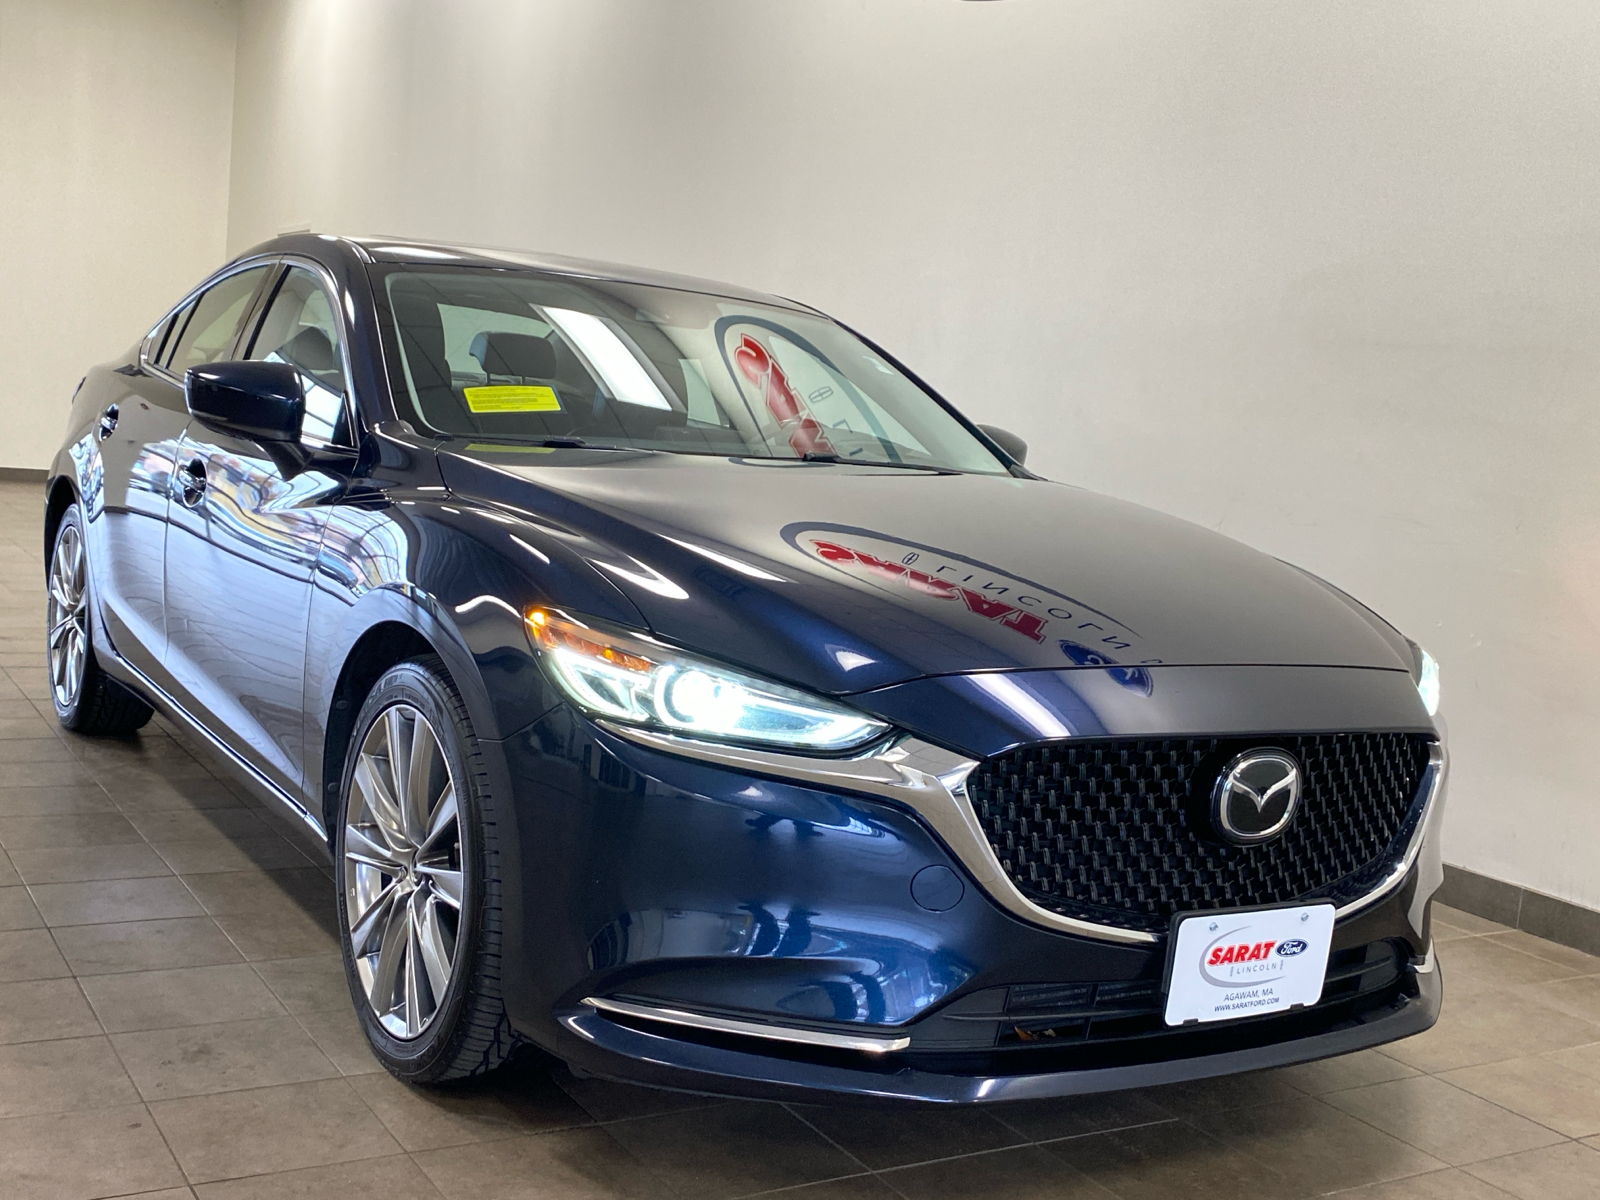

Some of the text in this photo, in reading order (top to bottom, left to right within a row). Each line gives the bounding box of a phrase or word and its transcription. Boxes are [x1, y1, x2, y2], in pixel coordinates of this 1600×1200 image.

[1207, 941, 1304, 966] SARAT Ford
[1236, 963, 1277, 974] LINCOLN
[1224, 988, 1274, 1001] AGAWAM, MA
[1214, 997, 1280, 1012] WWW.SARATFORD.COM
